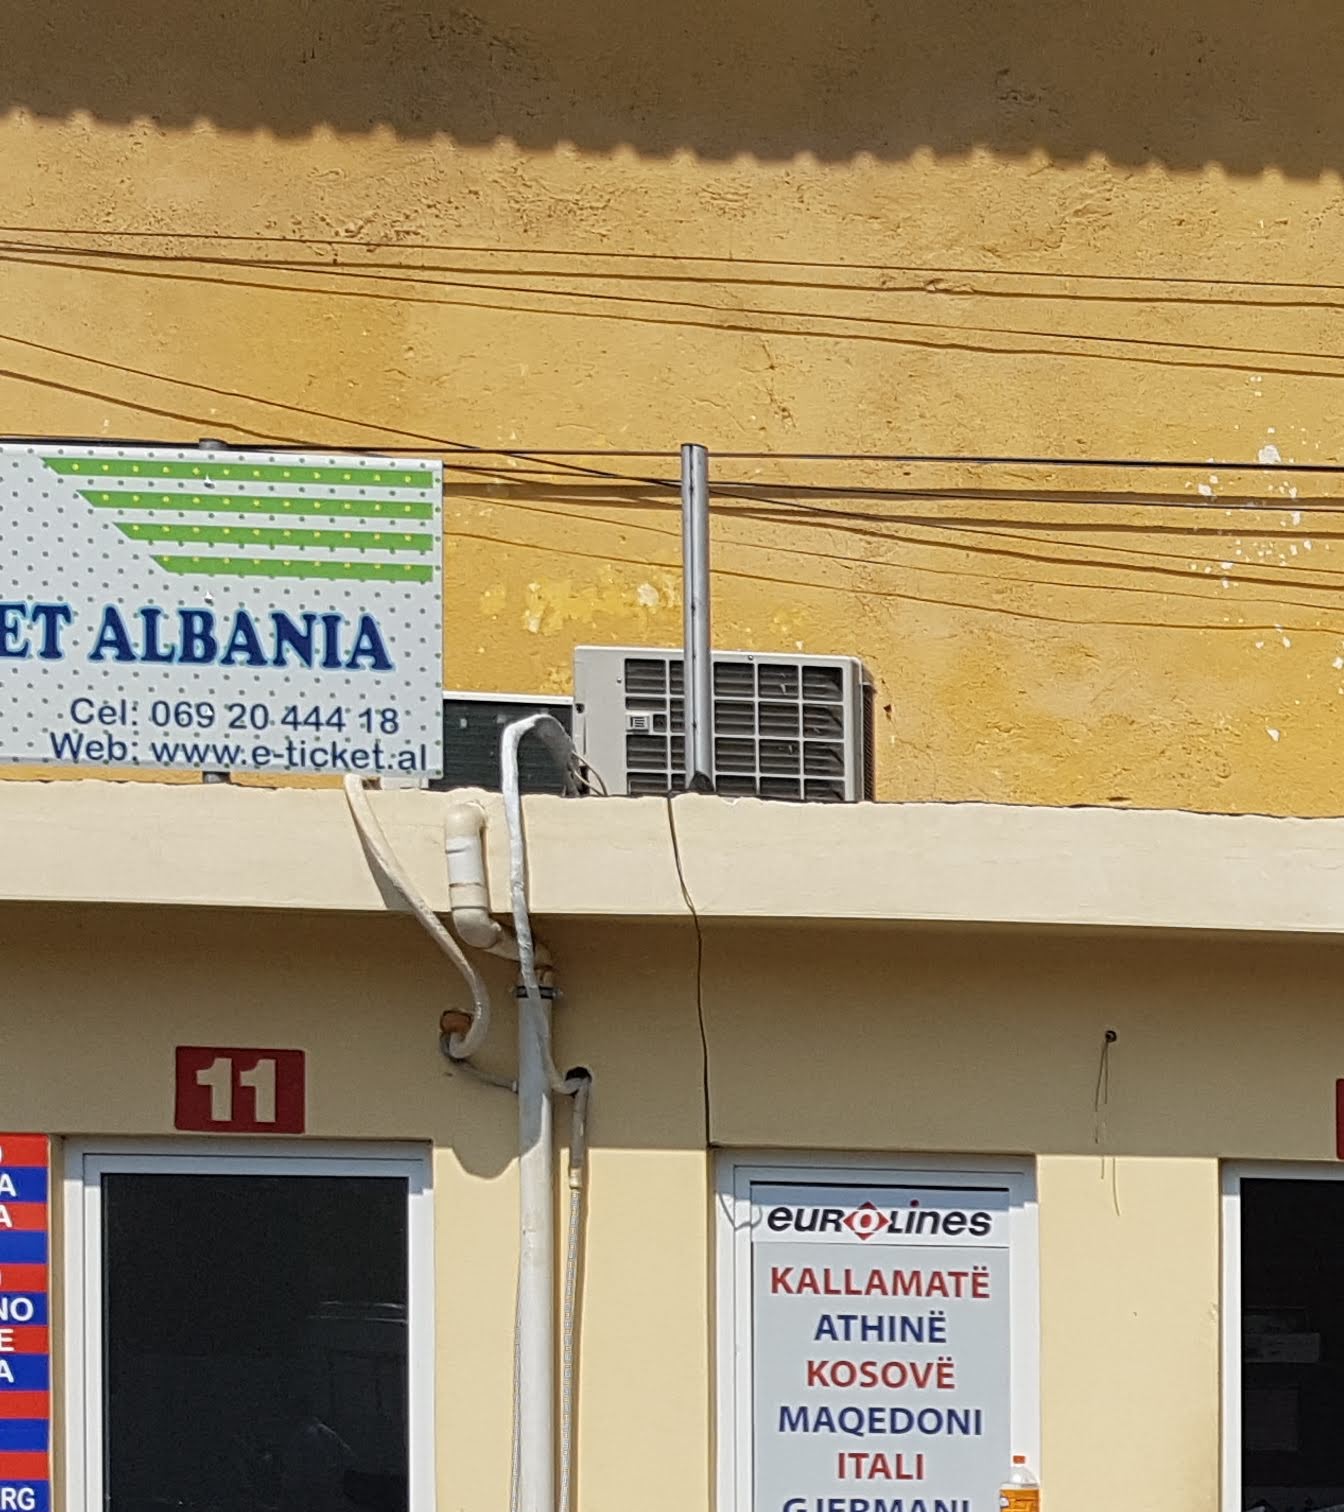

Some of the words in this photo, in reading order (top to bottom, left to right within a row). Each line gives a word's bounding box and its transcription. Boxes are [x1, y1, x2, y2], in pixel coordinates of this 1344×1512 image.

[89, 606, 396, 671] ALBANIA
[70, 698, 138, 727] Cel:
[151, 701, 216, 729] 069
[229, 703, 276, 731] 20
[281, 705, 348, 733] 444
[361, 707, 400, 735] 18
[50, 732, 138, 763] Web:
[151, 738, 428, 772] www.e-ticket.al
[196, 1057, 277, 1123] 11
[770, 1265, 991, 1300] KALLAMATË
[813, 1310, 947, 1344] ATHINË
[806, 1356, 956, 1389] KOSOVË
[778, 1405, 982, 1437] MAQEDONI
[837, 1452, 924, 1481] ITALI
